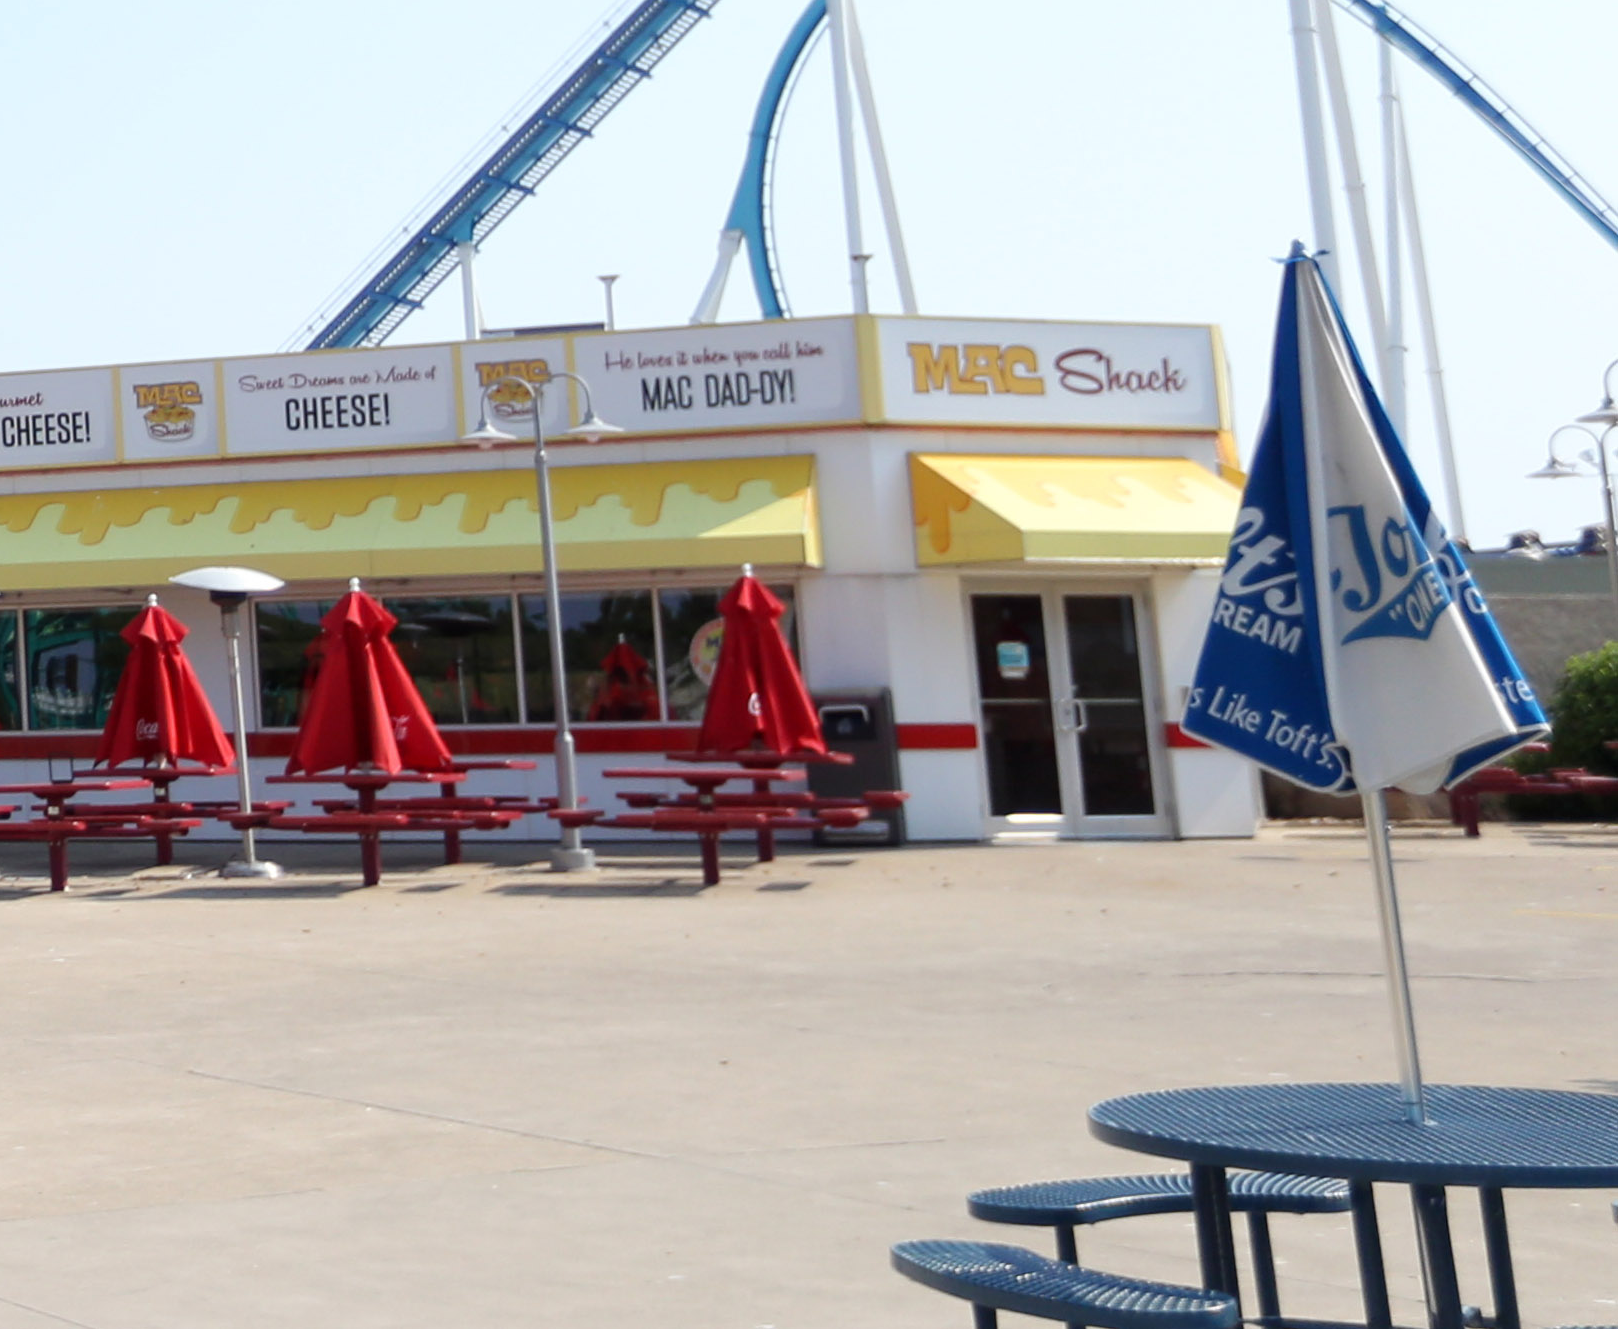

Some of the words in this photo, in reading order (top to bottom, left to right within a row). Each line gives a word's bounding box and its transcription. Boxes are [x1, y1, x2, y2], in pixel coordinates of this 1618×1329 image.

[475, 358, 552, 387] MAC
[605, 350, 634, 371] He
[638, 352, 673, 369] loves
[676, 351, 688, 366] it
[692, 347, 729, 364] when
[734, 350, 760, 366] you
[762, 343, 790, 360] call
[795, 340, 824, 357] him
[907, 342, 1046, 396] MAC
[1054, 347, 1187, 395] Shack
[133, 381, 203, 409] MAC
[238, 375, 284, 393] Sweet
[288, 373, 344, 389] Dreams
[349, 375, 371, 385] are
[374, 365, 421, 384] Made
[424, 366, 437, 380] of
[641, 375, 693, 412] MAC
[705, 369, 796, 408] DAD-DY!
[2, 411, 91, 448] CHEESE!
[284, 392, 391, 431] CHEESE!
[1214, 598, 1304, 655] REAM
[1207, 686, 1262, 733] Like
